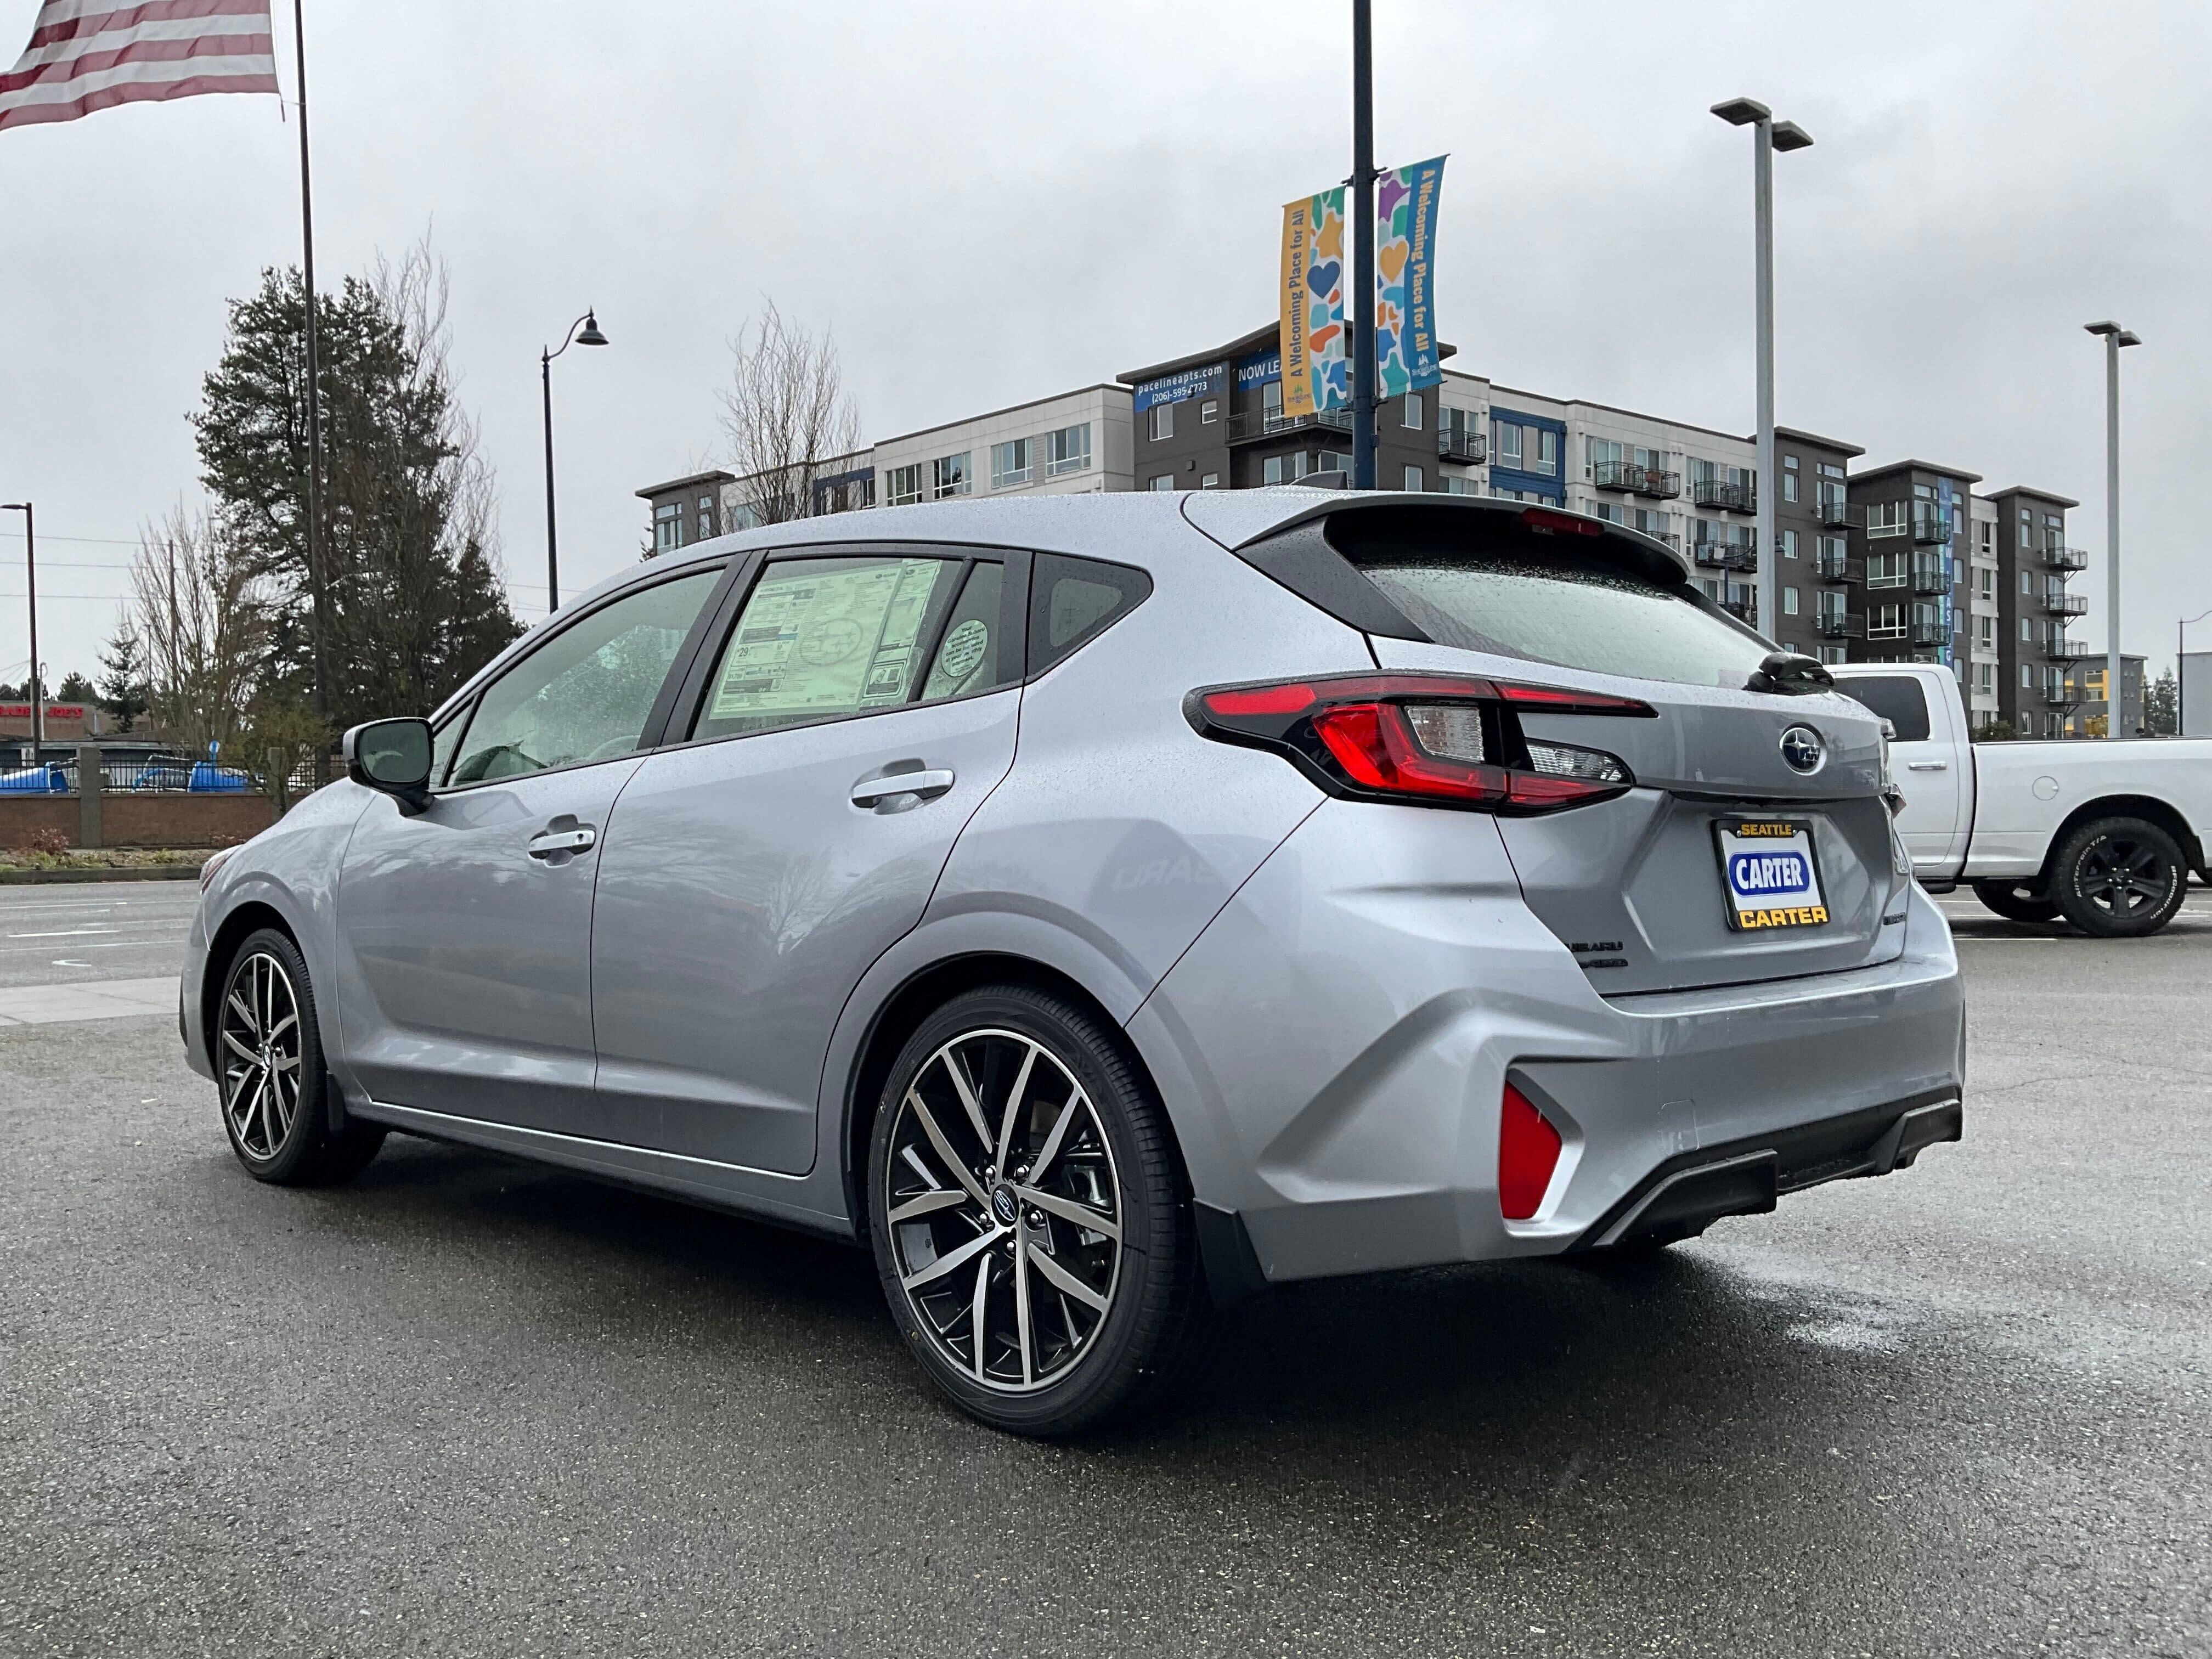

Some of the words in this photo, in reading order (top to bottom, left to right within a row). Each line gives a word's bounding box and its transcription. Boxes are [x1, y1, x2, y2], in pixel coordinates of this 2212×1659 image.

[1422, 169, 1436, 179] A
[1292, 208, 1304, 225] All
[1411, 179, 1434, 263] Welcoming
[1290, 229, 1304, 249] for
[1289, 252, 1302, 289] Place
[1413, 262, 1427, 304] Place
[1414, 306, 1427, 329] for
[1289, 290, 1304, 367] Welcoming
[1415, 333, 1429, 351] All
[1138, 364, 1222, 396] pacelineapts.com
[1238, 364, 1266, 382] NOW
[1291, 368, 1303, 377] A
[1741, 824, 1792, 836] SEATTLE
[1736, 857, 1804, 890] CARTER
[1739, 907, 1829, 928] CARTER
